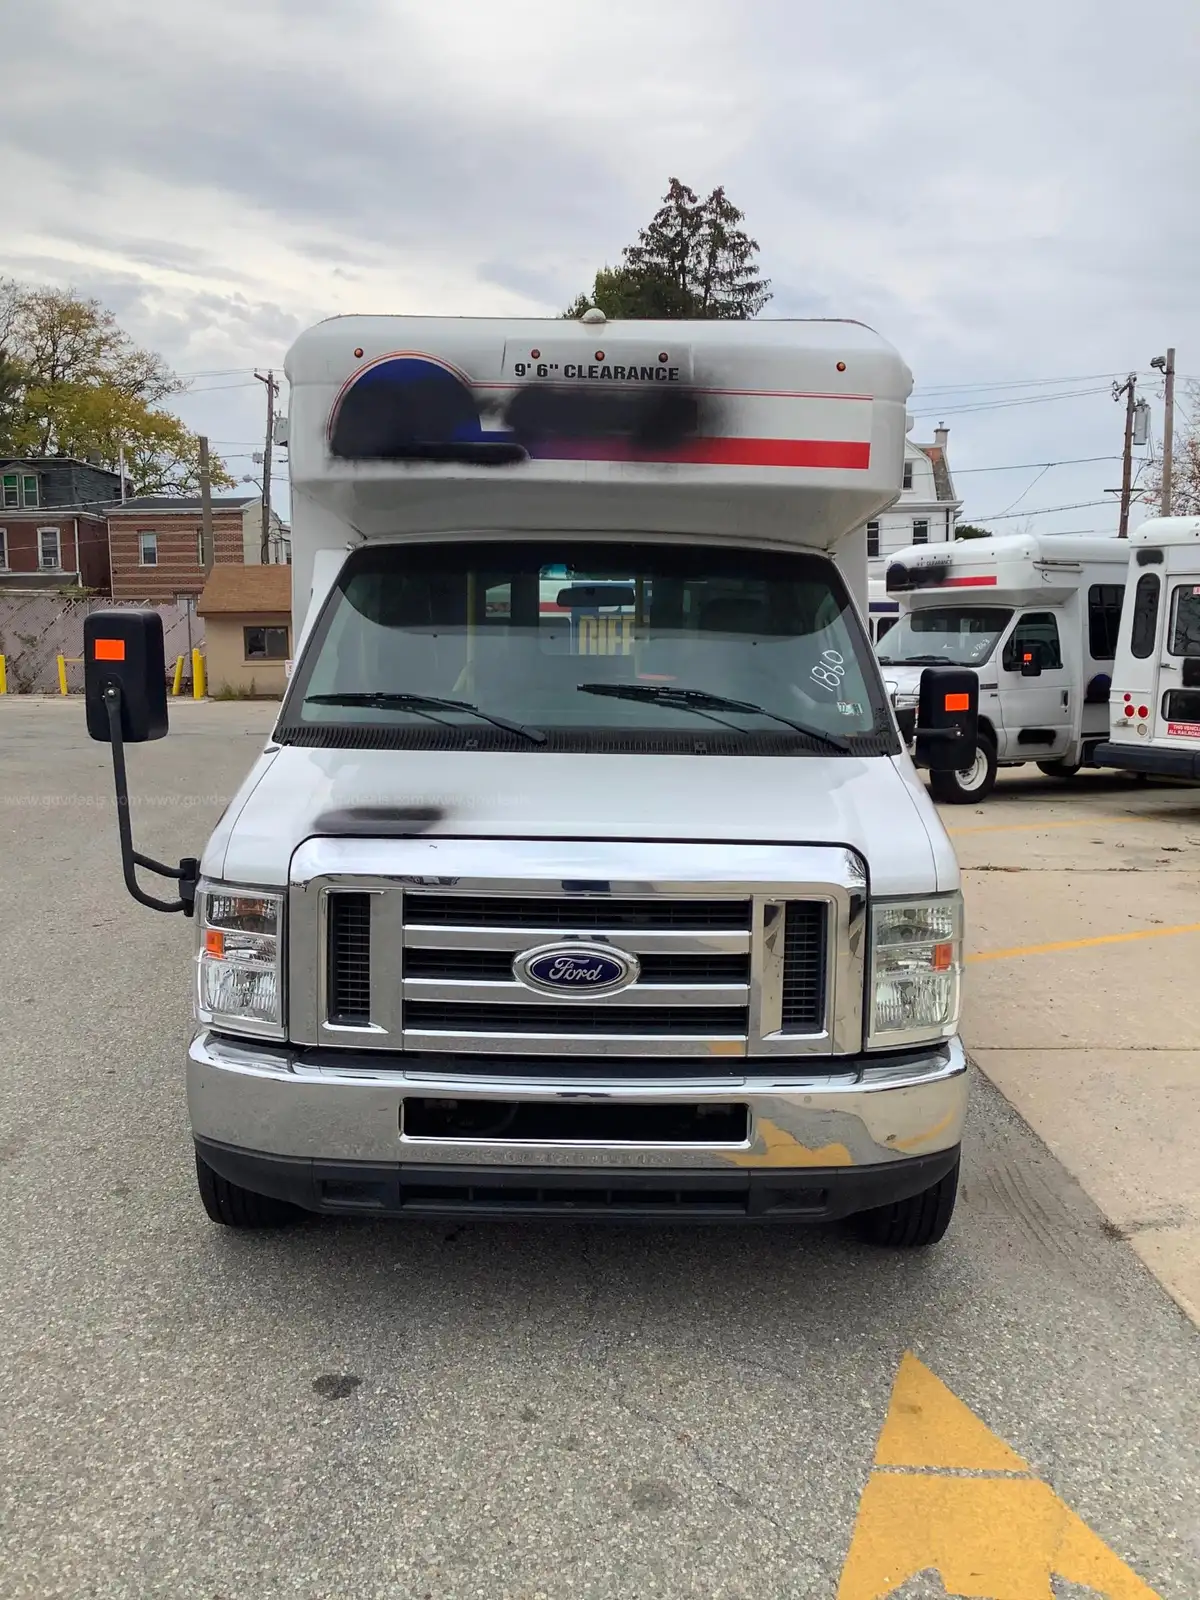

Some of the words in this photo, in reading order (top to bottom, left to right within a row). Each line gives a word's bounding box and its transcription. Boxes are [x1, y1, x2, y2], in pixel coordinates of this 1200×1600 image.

[514, 362, 532, 377] 9'
[536, 363, 559, 377] 6"
[564, 364, 679, 381] CLEARANCE
[809, 649, 845, 692] 1860
[548, 957, 603, 981] Ford
